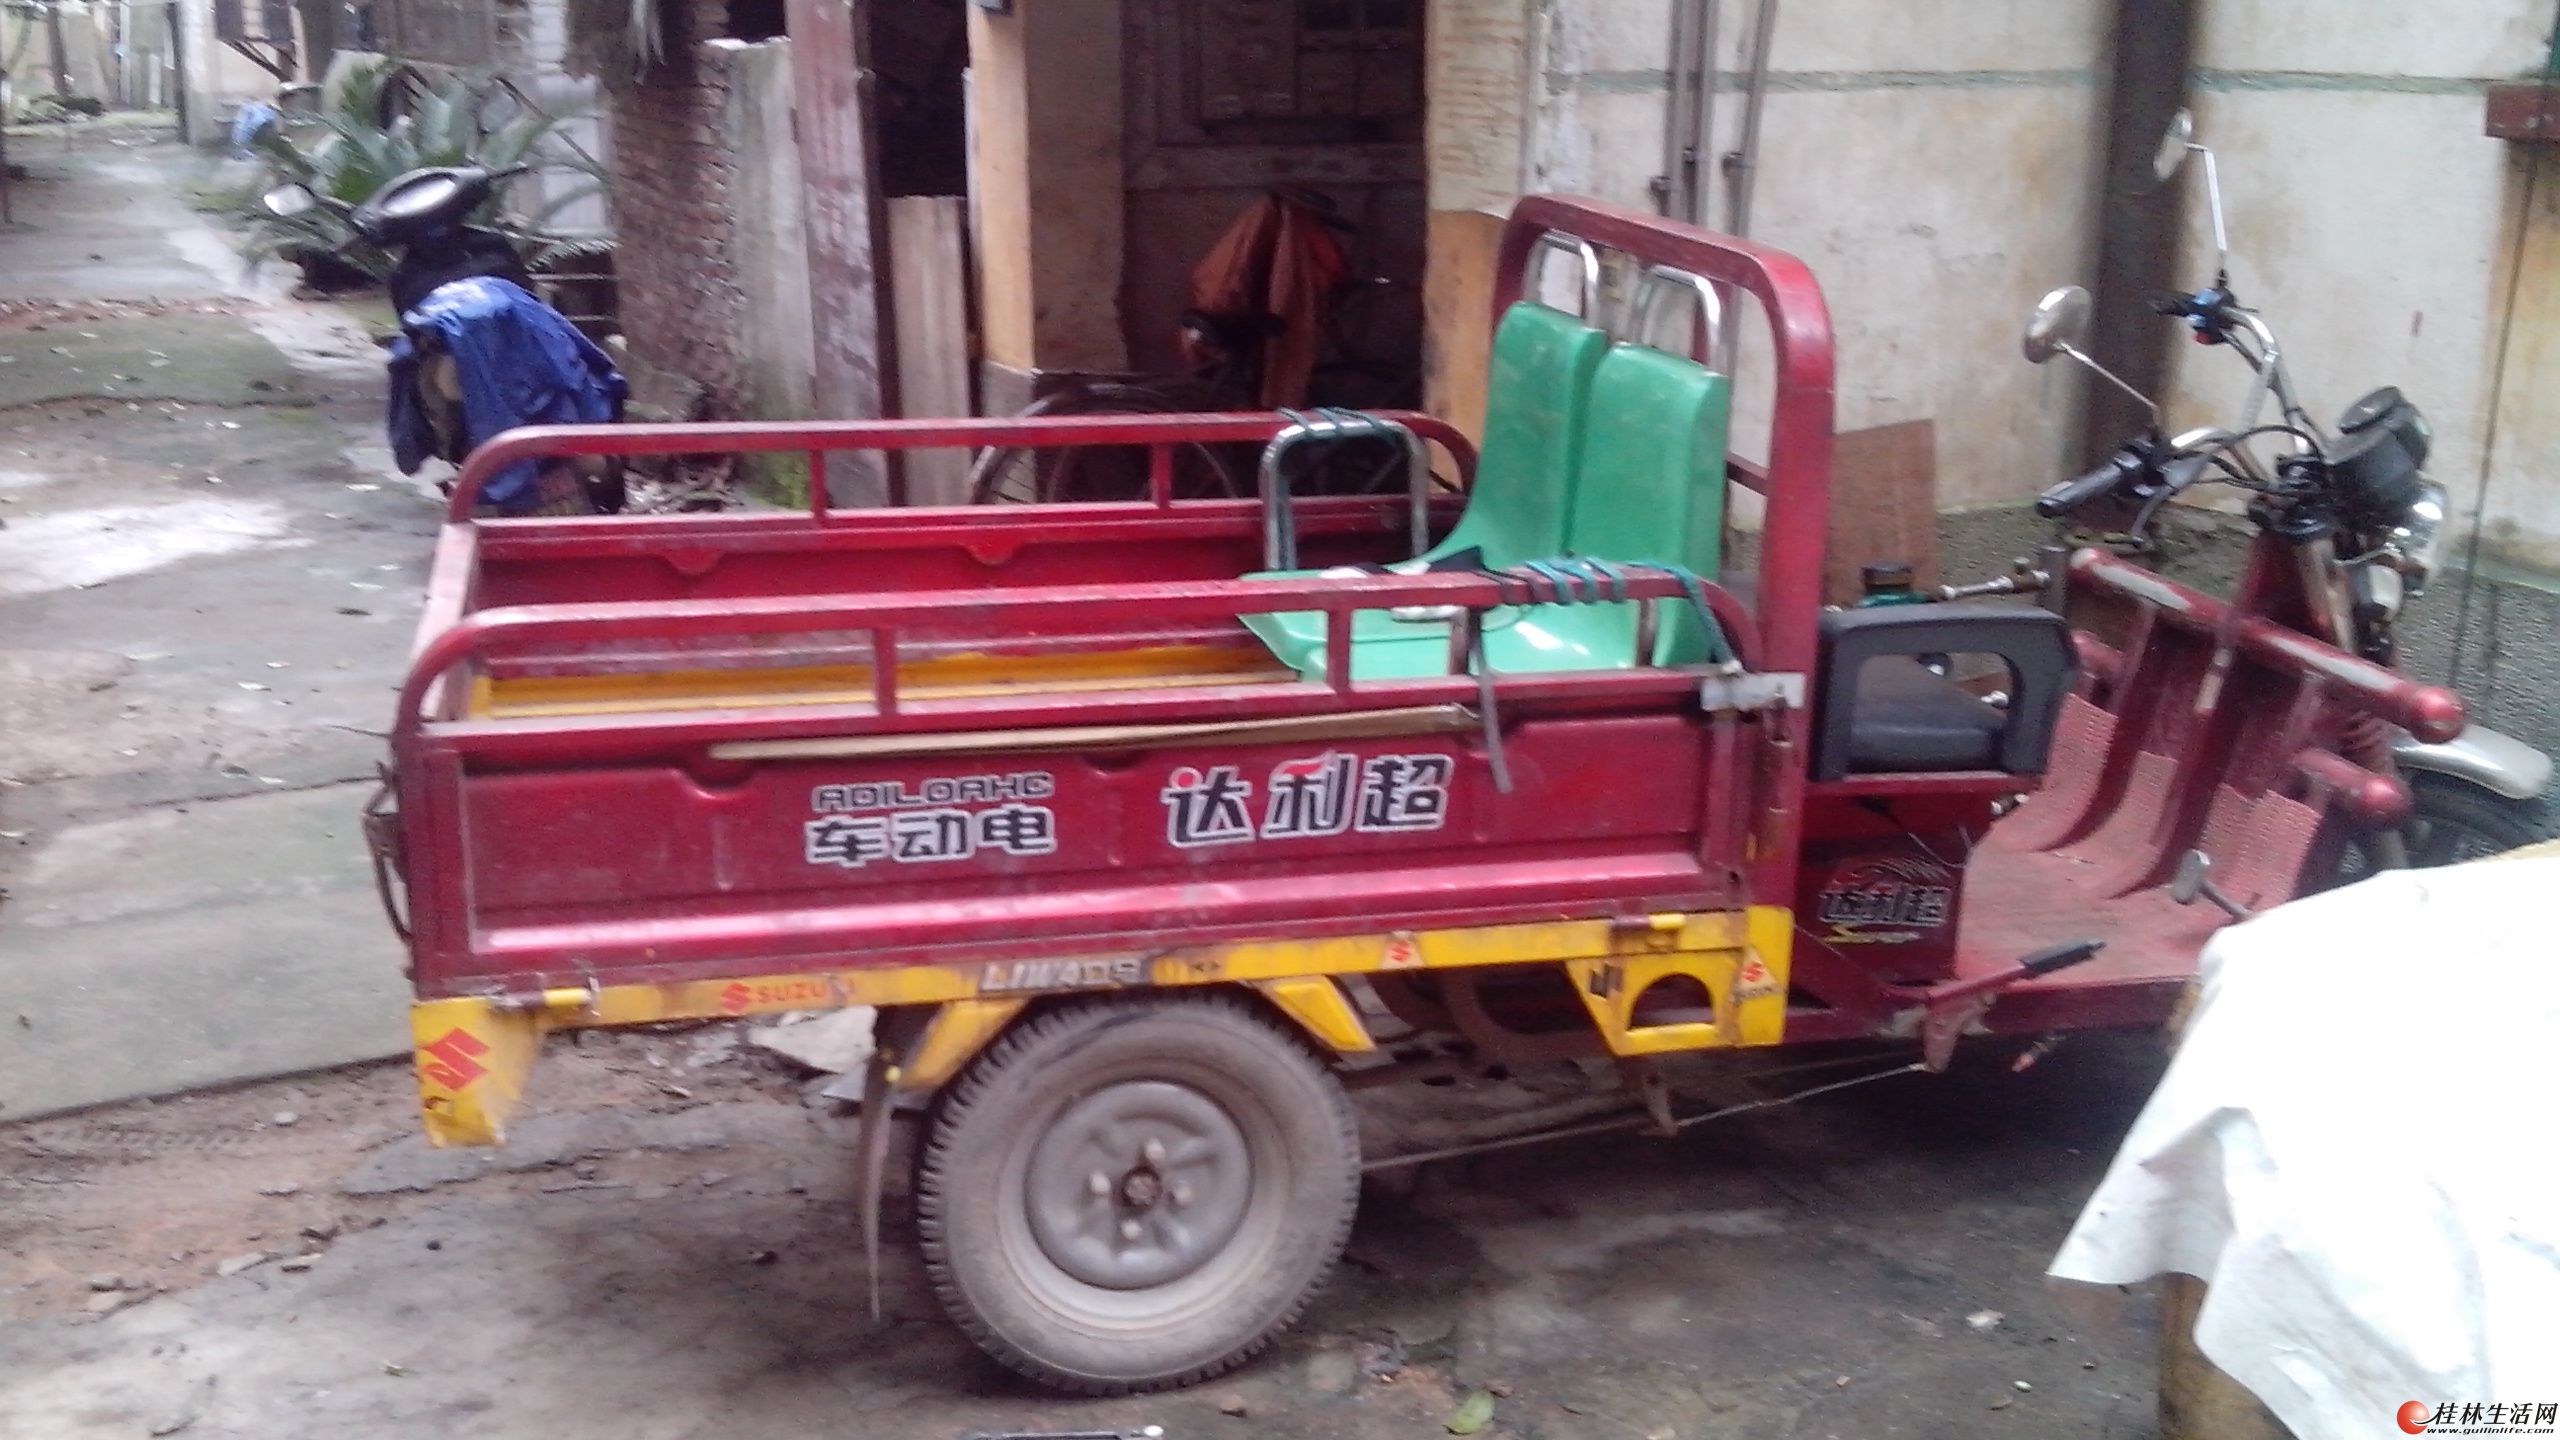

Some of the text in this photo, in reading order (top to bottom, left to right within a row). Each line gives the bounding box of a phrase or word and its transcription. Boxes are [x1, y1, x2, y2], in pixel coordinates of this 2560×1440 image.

[805, 803, 1057, 867] 车动电
[1160, 750, 1453, 847] 达利超
